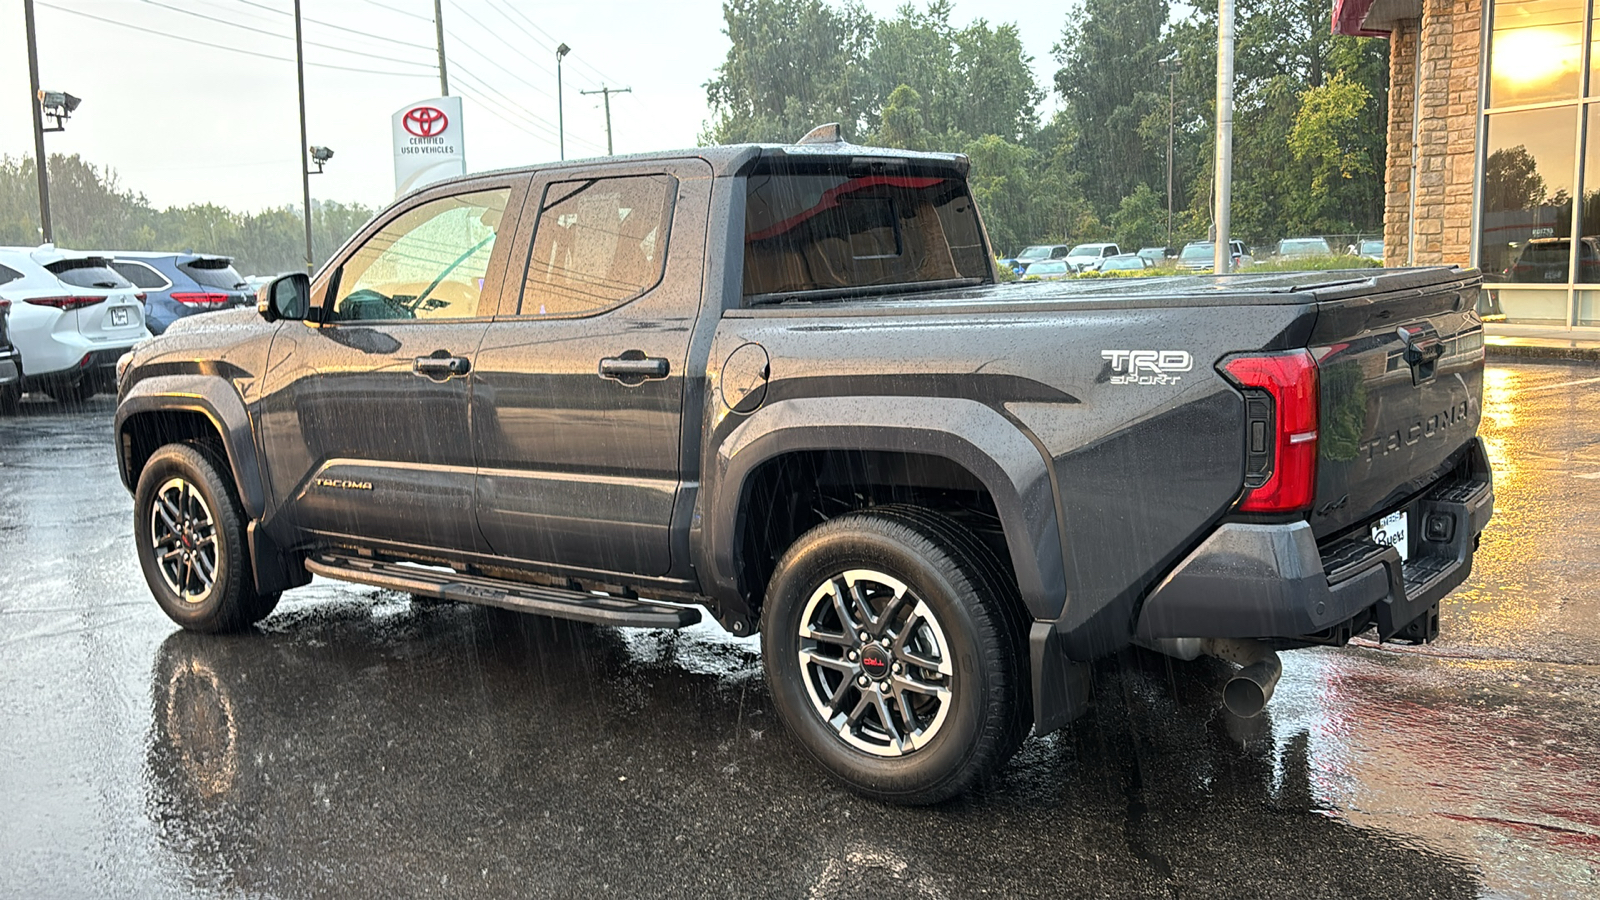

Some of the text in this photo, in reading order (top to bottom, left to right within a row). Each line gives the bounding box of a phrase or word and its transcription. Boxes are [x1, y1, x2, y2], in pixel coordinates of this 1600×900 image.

[409, 137, 444, 145] CERTIFIED
[401, 146, 454, 155] USED VEHICLES
[1101, 350, 1193, 377] TRD
[1110, 374, 1181, 385] SPORT
[1359, 400, 1468, 463] TACOMA
[315, 478, 373, 490] TACOMA
